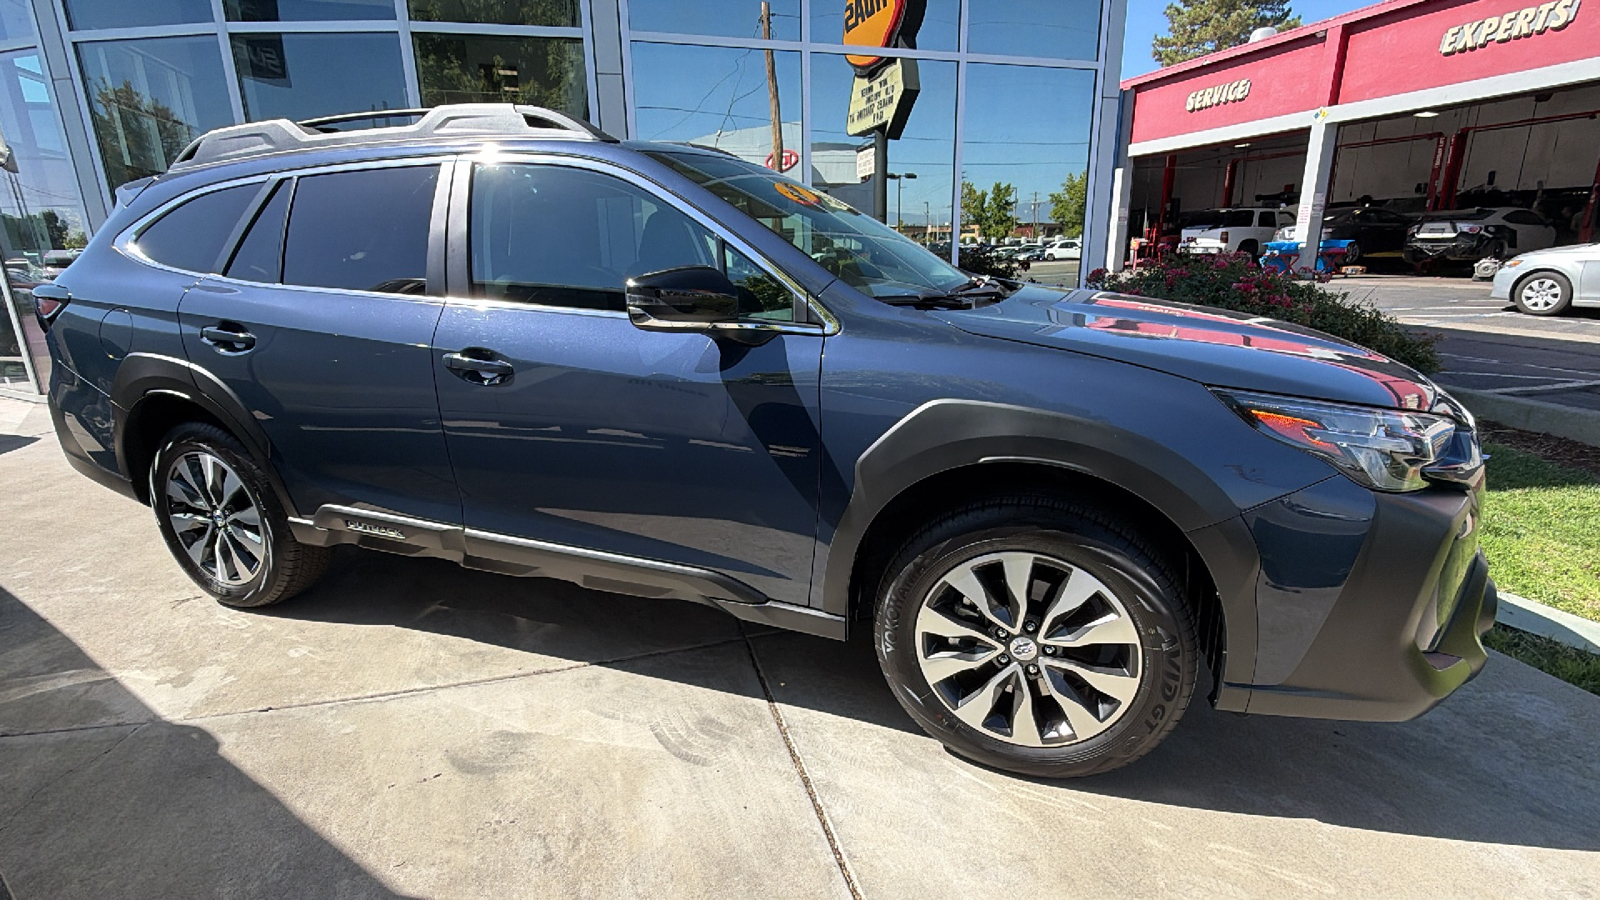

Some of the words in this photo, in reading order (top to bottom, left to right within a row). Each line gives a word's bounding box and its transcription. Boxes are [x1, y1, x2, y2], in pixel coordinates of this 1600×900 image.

[1441, 0, 1578, 54] EXPERTS
[1186, 79, 1252, 112] SERVICE
[1156, 626, 1182, 702] AVID
[1144, 704, 1167, 735] GT
